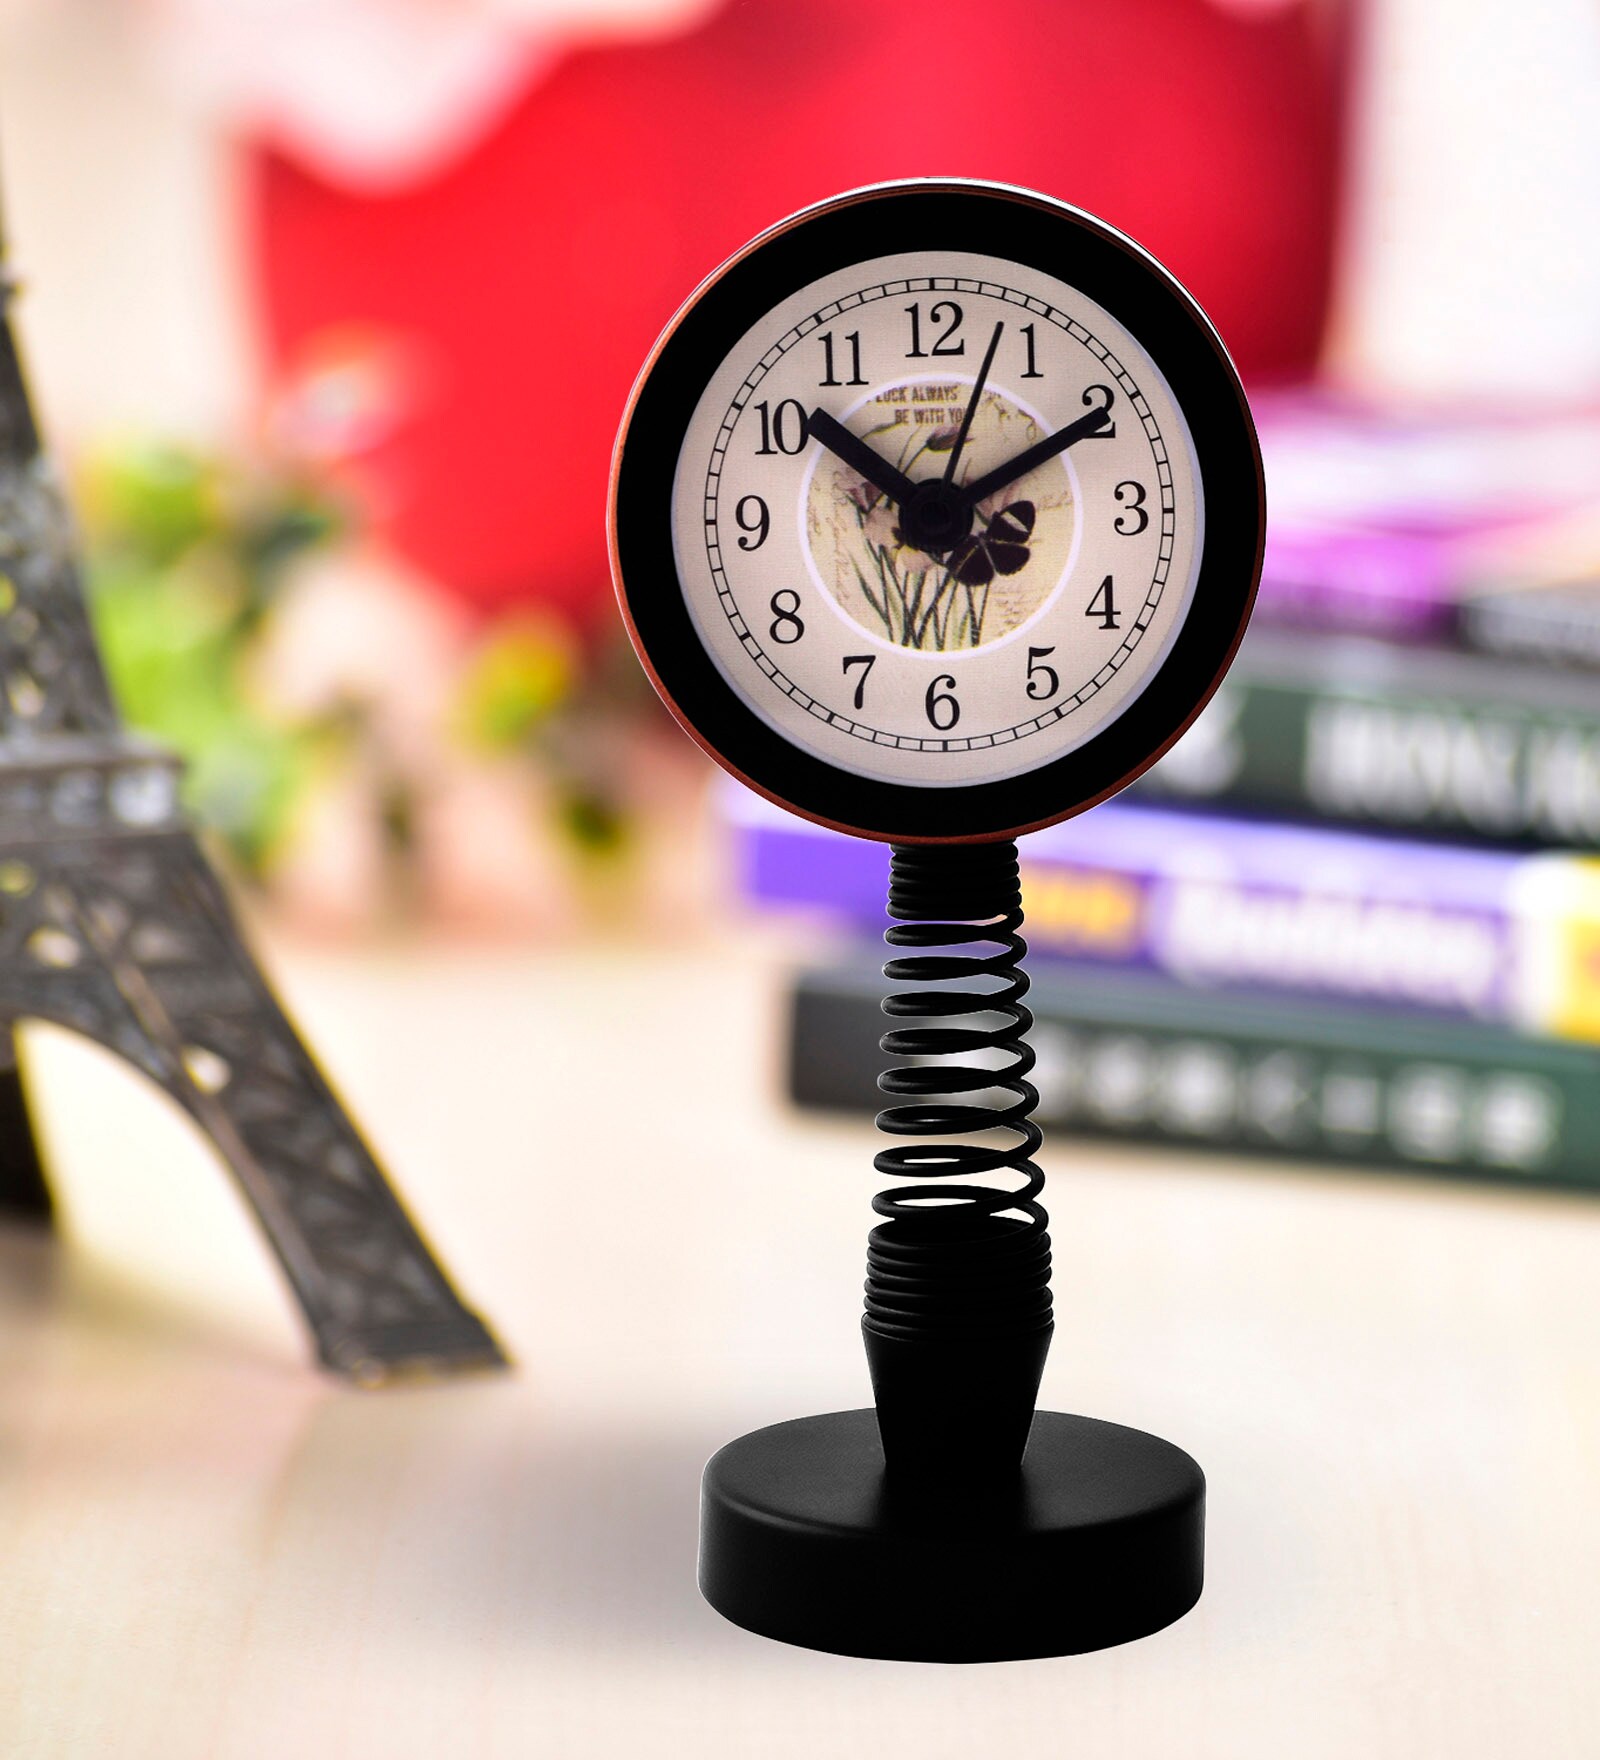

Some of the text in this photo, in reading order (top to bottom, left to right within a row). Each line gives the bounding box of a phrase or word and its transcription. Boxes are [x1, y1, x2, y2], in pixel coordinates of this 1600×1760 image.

[905, 301, 965, 358] 12
[1020, 323, 1044, 378] 1
[818, 331, 869, 387] 11
[895, 408, 910, 424] BE
[914, 407, 945, 424] WITH
[912, 385, 958, 402] ALWAYS
[1081, 384, 1116, 439] 2
[754, 399, 809, 455] 10
[735, 495, 770, 552] 9
[1113, 481, 1149, 536] 3
[769, 589, 806, 644] 8
[1085, 575, 1122, 630] 4
[842, 655, 877, 710] 7
[1025, 646, 1060, 701] 5
[925, 674, 961, 731] 6
